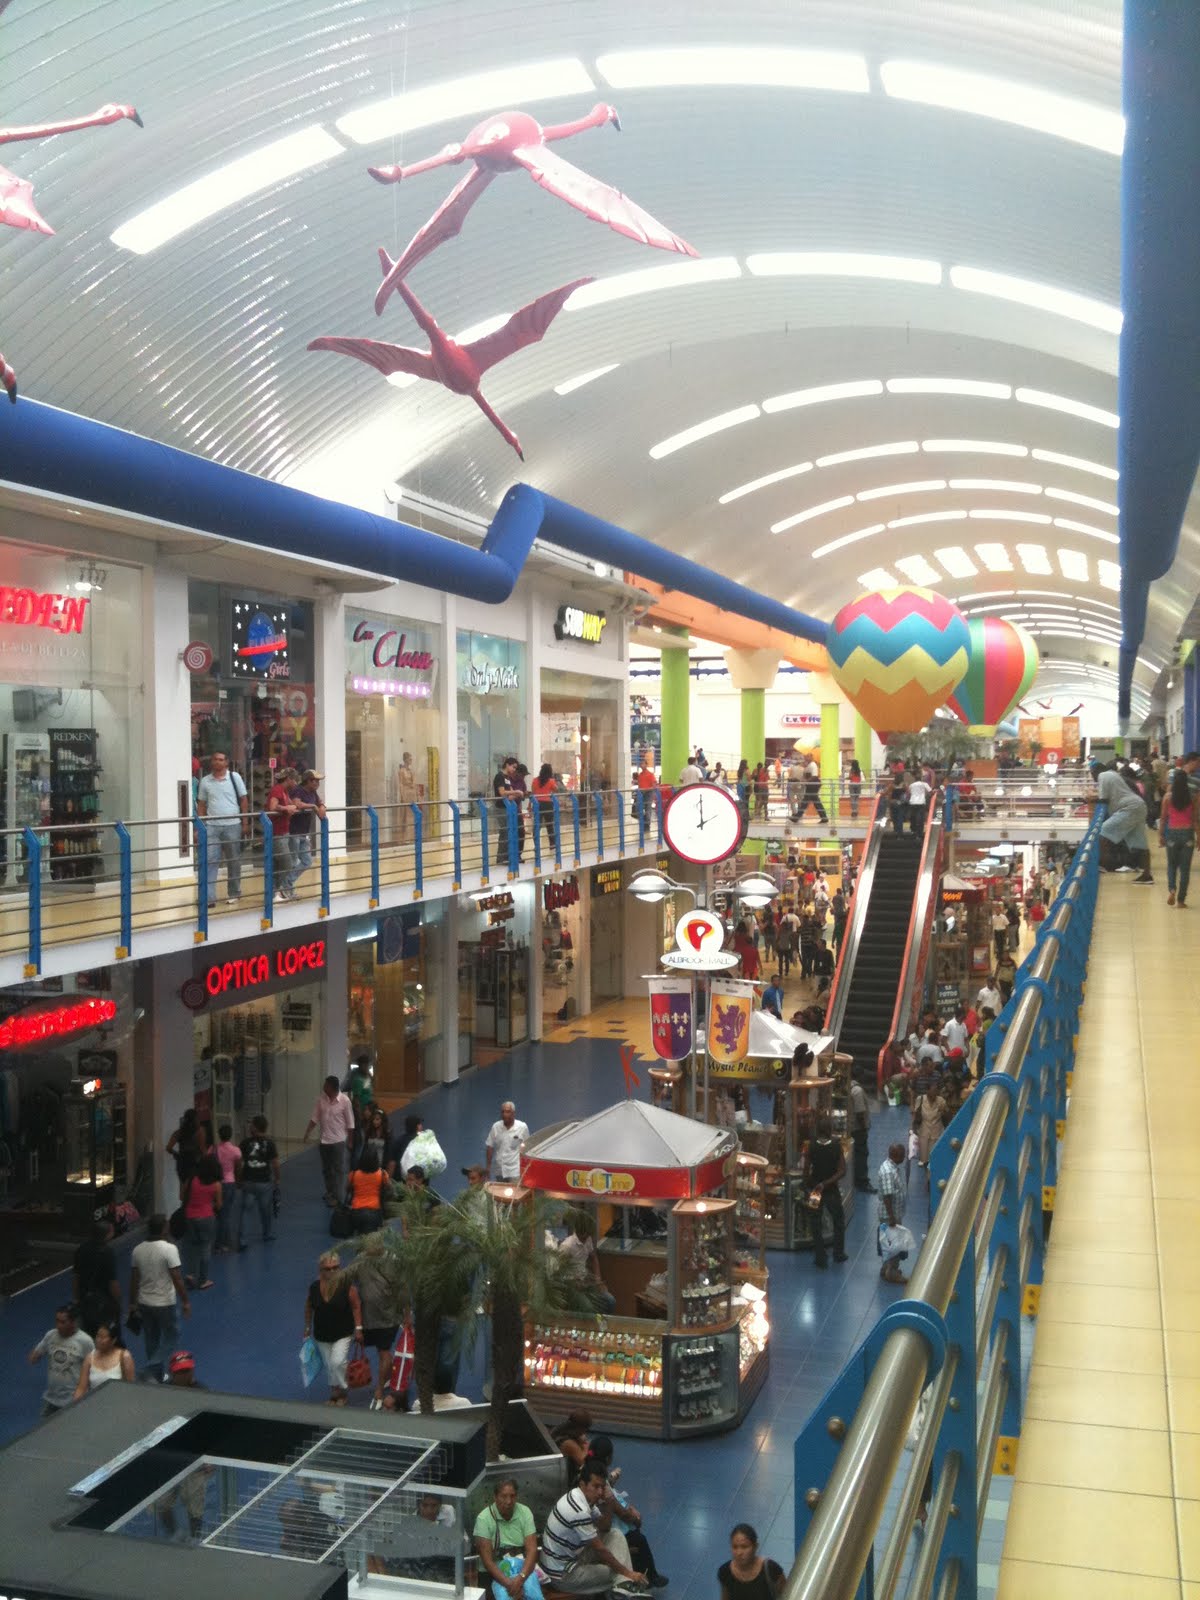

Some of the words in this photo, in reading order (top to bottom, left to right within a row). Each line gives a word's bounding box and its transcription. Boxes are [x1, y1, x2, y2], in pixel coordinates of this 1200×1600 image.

[562, 606, 606, 642] SUBWAY
[269, 661, 290, 679] Girls
[53, 732, 92, 742] REDKEN
[597, 869, 620, 884] WESTERN
[603, 880, 619, 894] UNION
[206, 954, 270, 996] OPTICA
[277, 940, 326, 977] LOPEZ
